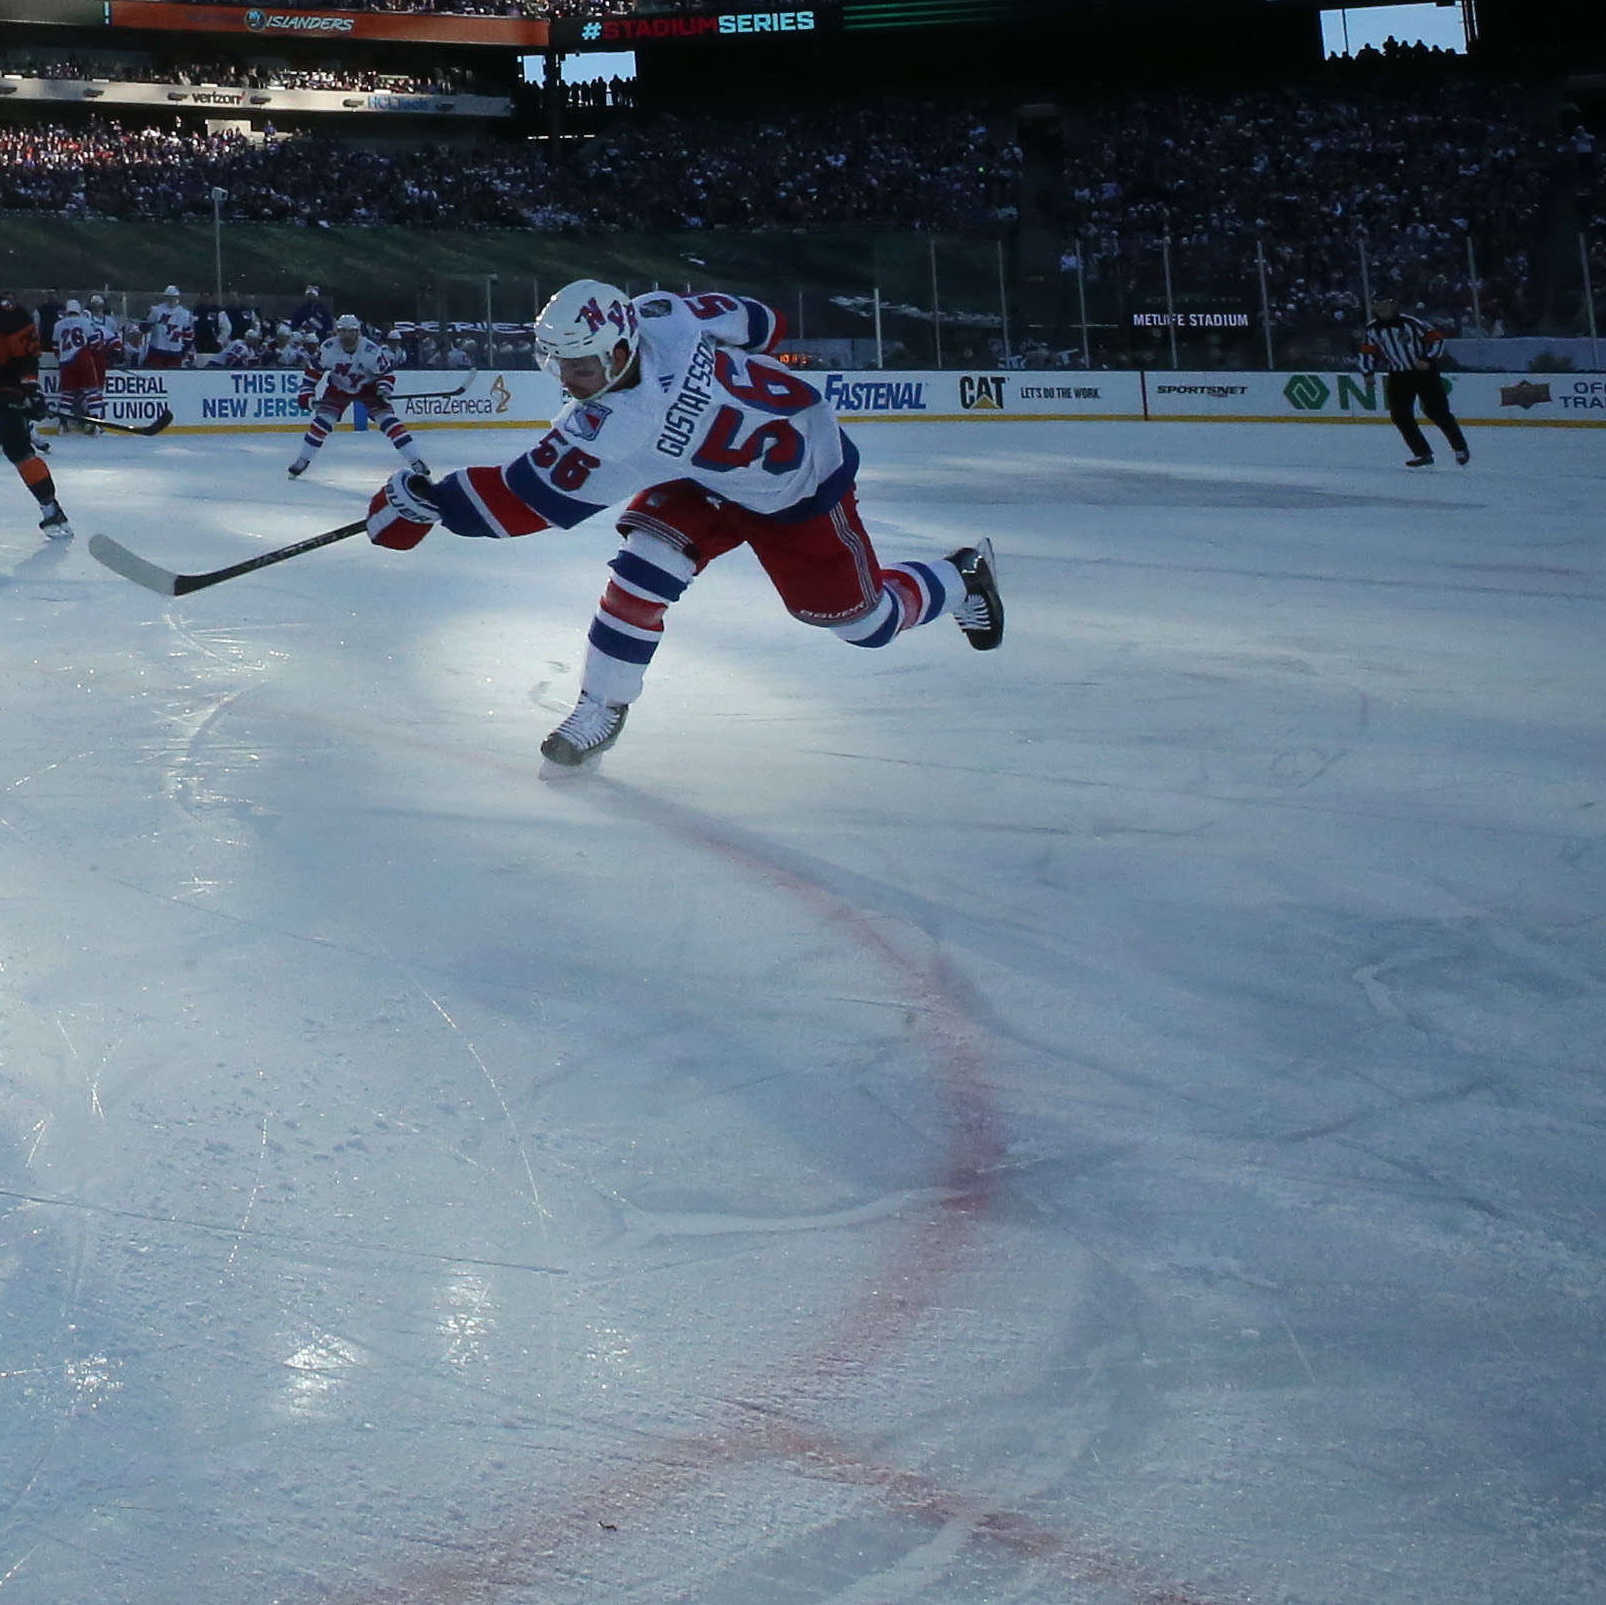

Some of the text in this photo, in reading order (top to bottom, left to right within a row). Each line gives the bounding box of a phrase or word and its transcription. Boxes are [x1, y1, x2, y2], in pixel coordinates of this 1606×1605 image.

[266, 16, 355, 31] ISLANDERS
[582, 11, 815, 41] #STADIUMSERIES
[191, 93, 239, 105] verizon
[1189, 313, 1248, 326] STADIUM
[230, 374, 299, 393] THIS IS
[825, 374, 926, 410] FASTENAL
[1156, 385, 1248, 395] SPORTSNET
[1574, 382, 1606, 394] OF
[959, 376, 1005, 410] CAT
[1021, 387, 1042, 399] LET'S
[1059, 387, 1074, 399] THE
[113, 401, 168, 419] UNION
[203, 398, 248, 418] NEW
[405, 397, 493, 415] AstraZeneca
[1560, 396, 1606, 409] TRA
[691, 351, 822, 477] 56
[530, 428, 601, 490] 56
